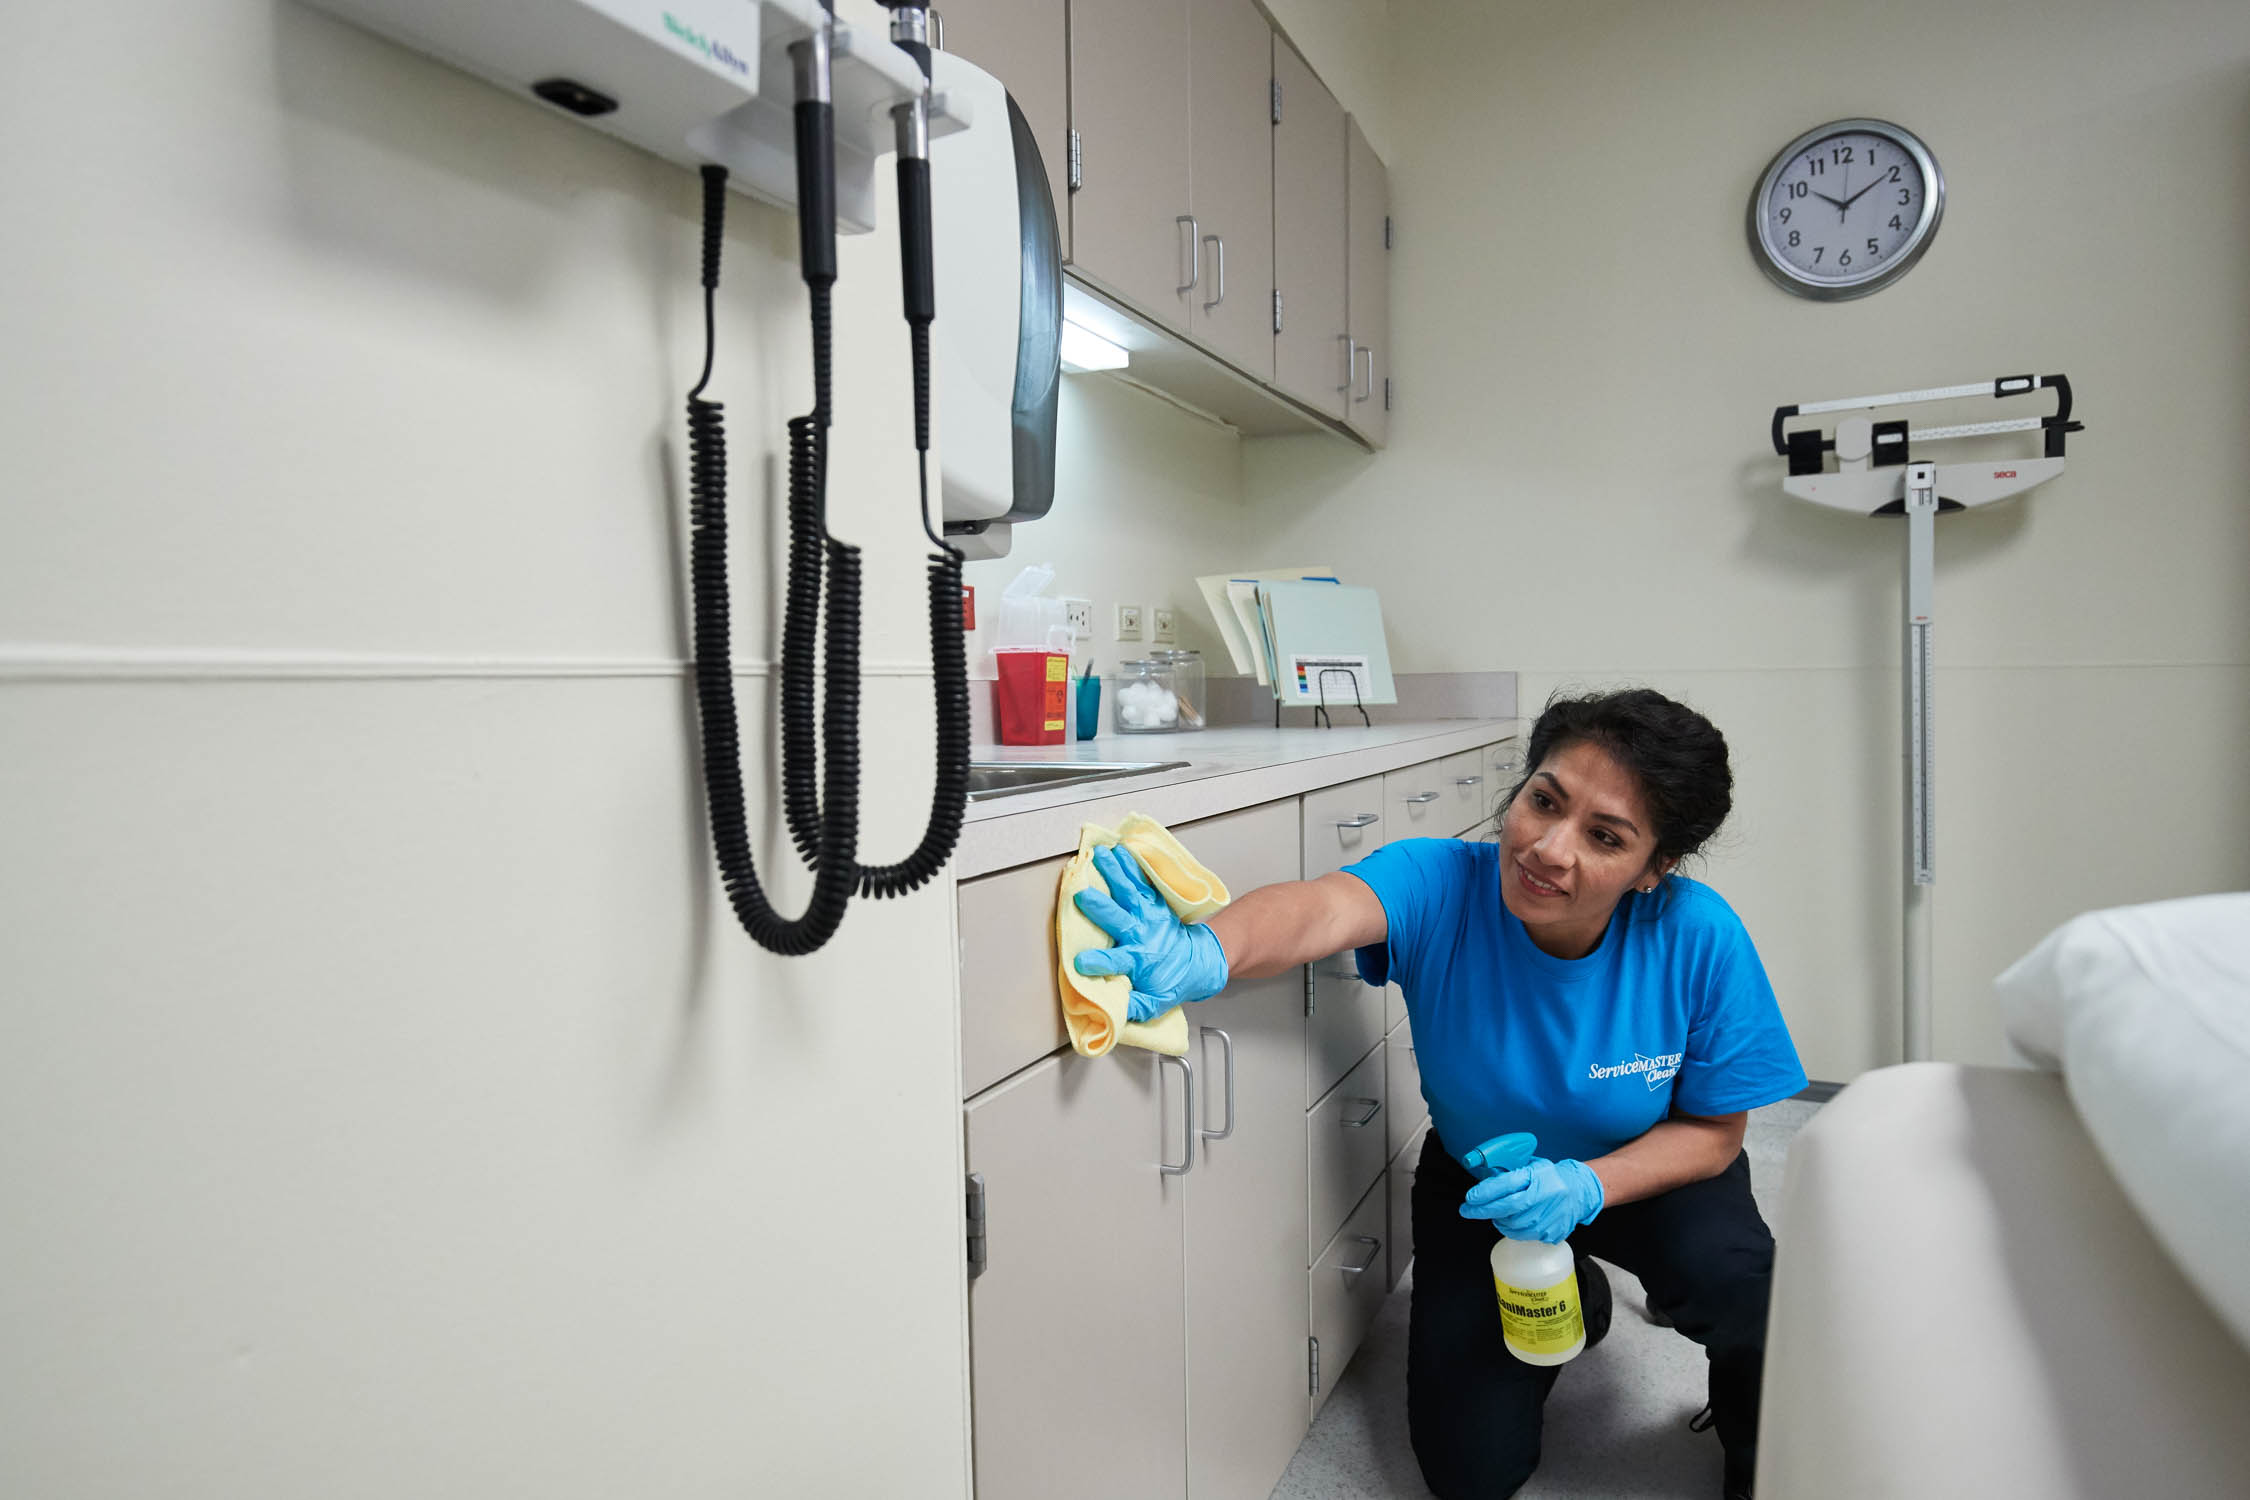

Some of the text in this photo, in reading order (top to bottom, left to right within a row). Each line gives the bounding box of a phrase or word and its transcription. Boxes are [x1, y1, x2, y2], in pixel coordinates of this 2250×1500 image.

[1832, 147, 1854, 165] 12
[1868, 149, 1875, 166] 1
[1809, 158, 1824, 176] 11
[1888, 165, 1901, 183] 2
[1788, 181, 1808, 200] 10
[1898, 188, 1910, 206] 3
[1779, 207, 1792, 225] 9
[1888, 214, 1902, 231] 4
[1788, 230, 1801, 248] 8
[1867, 238, 1879, 255] 5
[1813, 247, 1825, 264] 7
[1839, 249, 1852, 267] 6
[1647, 1068, 1677, 1083] Clean
[1559, 1300, 1567, 1313] 6
